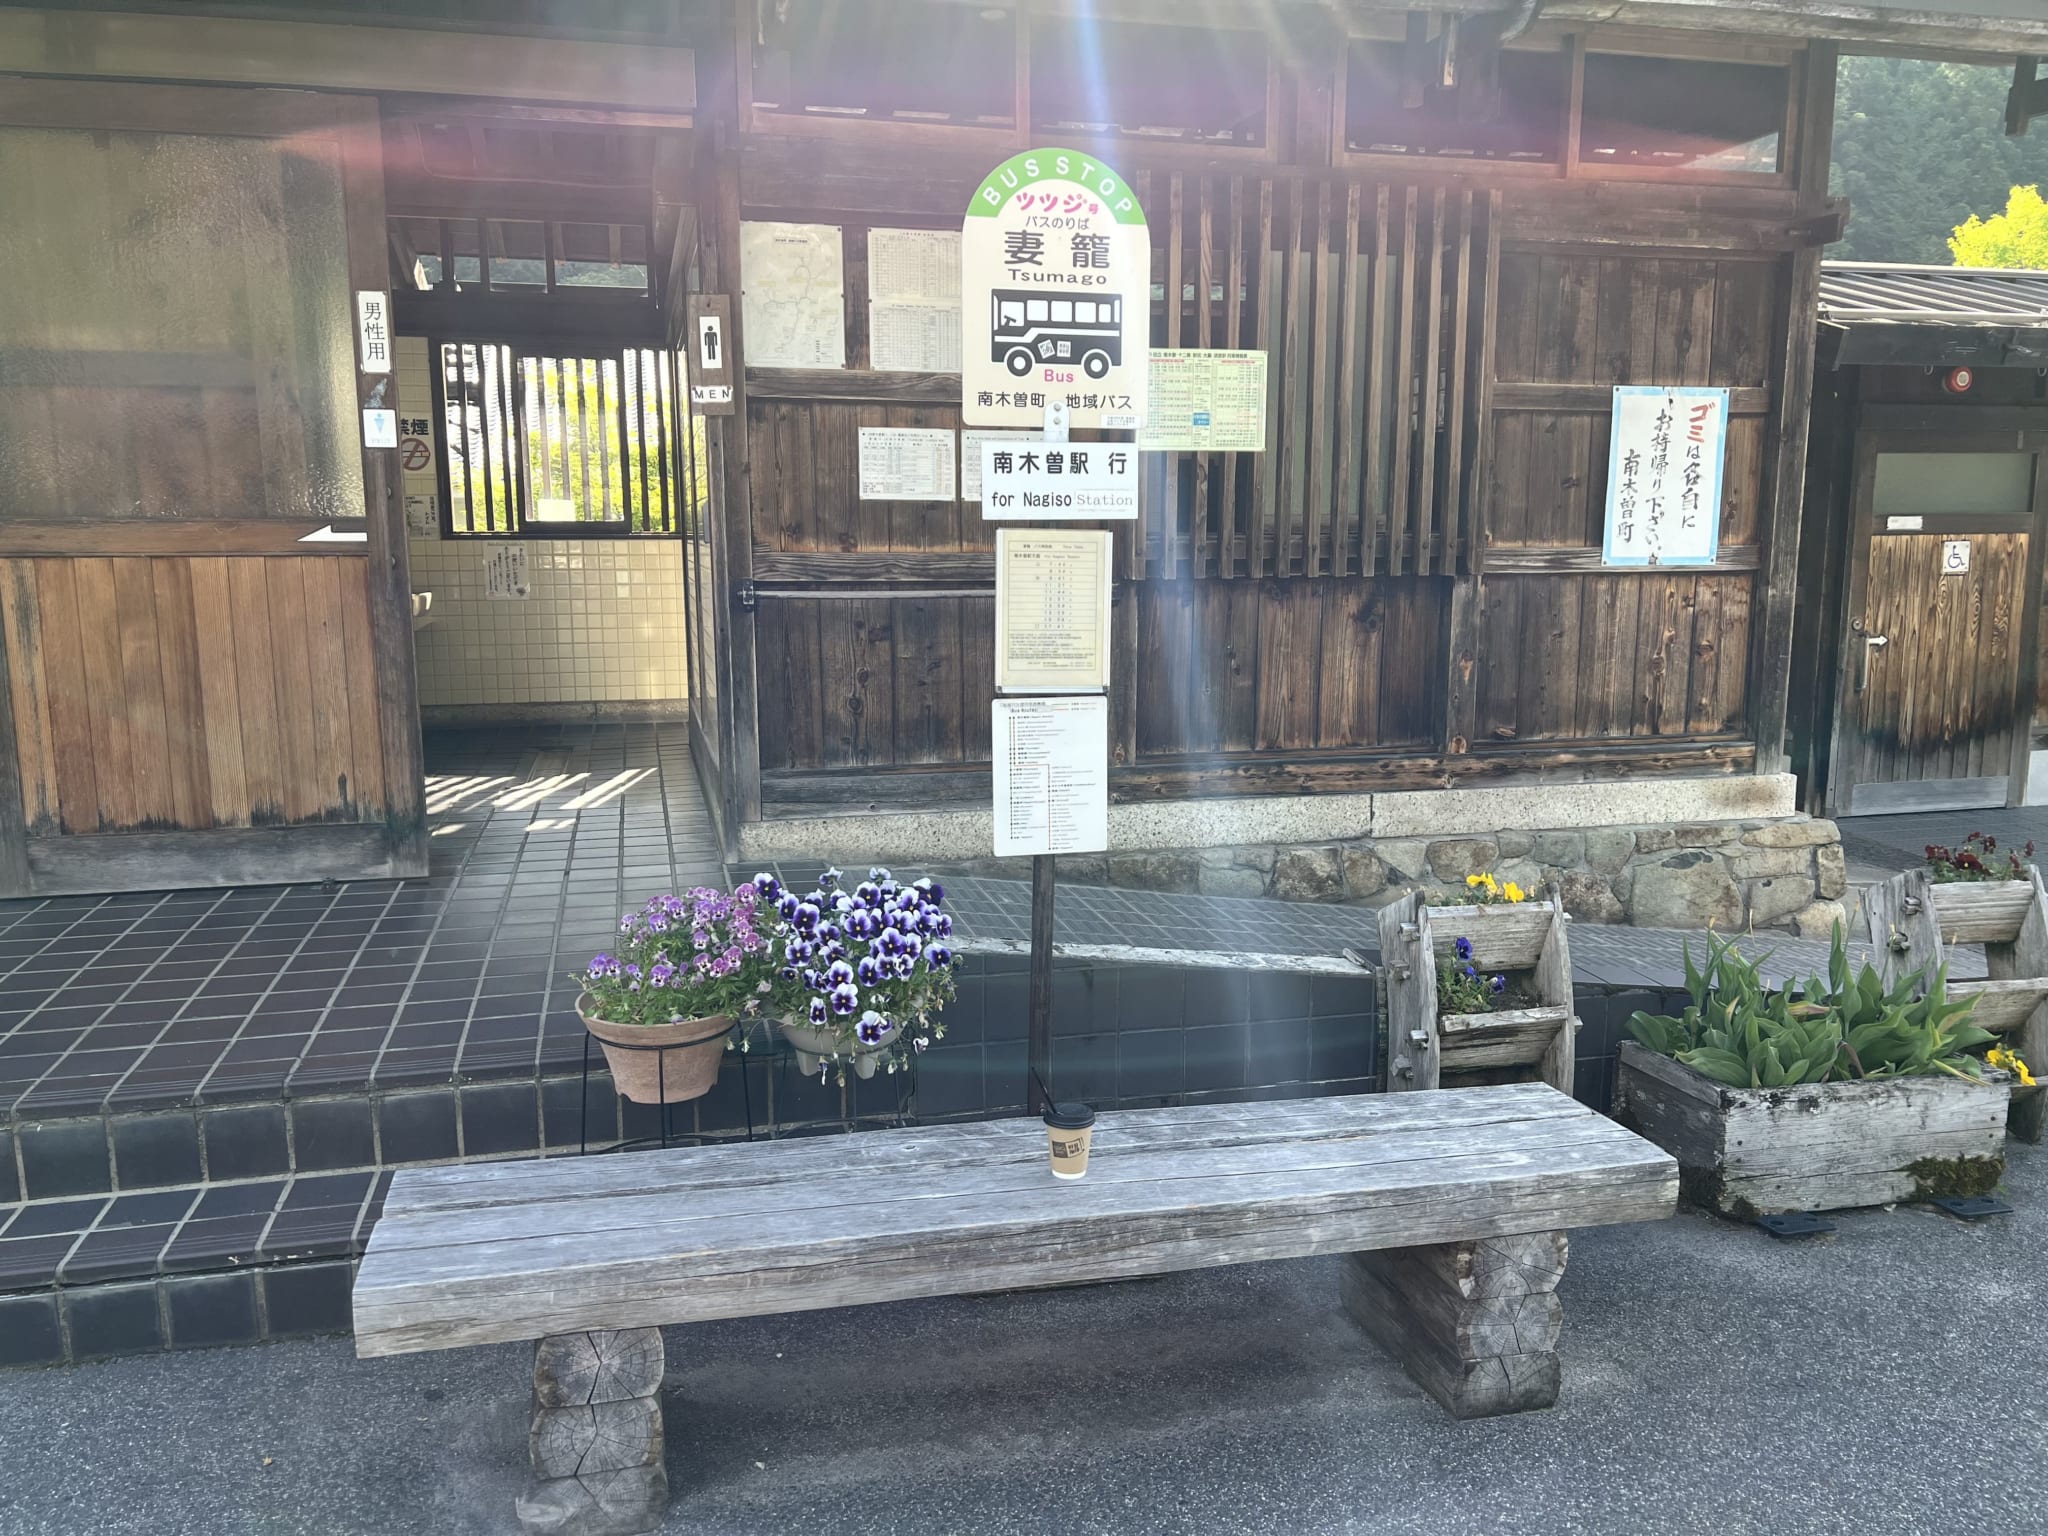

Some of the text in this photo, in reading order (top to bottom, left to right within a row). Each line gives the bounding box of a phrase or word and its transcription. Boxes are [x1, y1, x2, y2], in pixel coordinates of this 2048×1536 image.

[982, 156, 1133, 212] BUS STOP
[1016, 192, 1099, 214] ツツジ号
[1025, 216, 1090, 230] バスのりば
[1007, 268, 1107, 286] Tsumago
[364, 302, 385, 360] 男性用
[1044, 369, 1074, 383] Bus
[694, 389, 730, 399] MEN
[977, 391, 1132, 409] 南木曽町 地域バス
[993, 451, 1089, 475] 南木曽駅
[1108, 452, 1128, 475] 行
[992, 492, 1134, 508] for Nagiso Station
